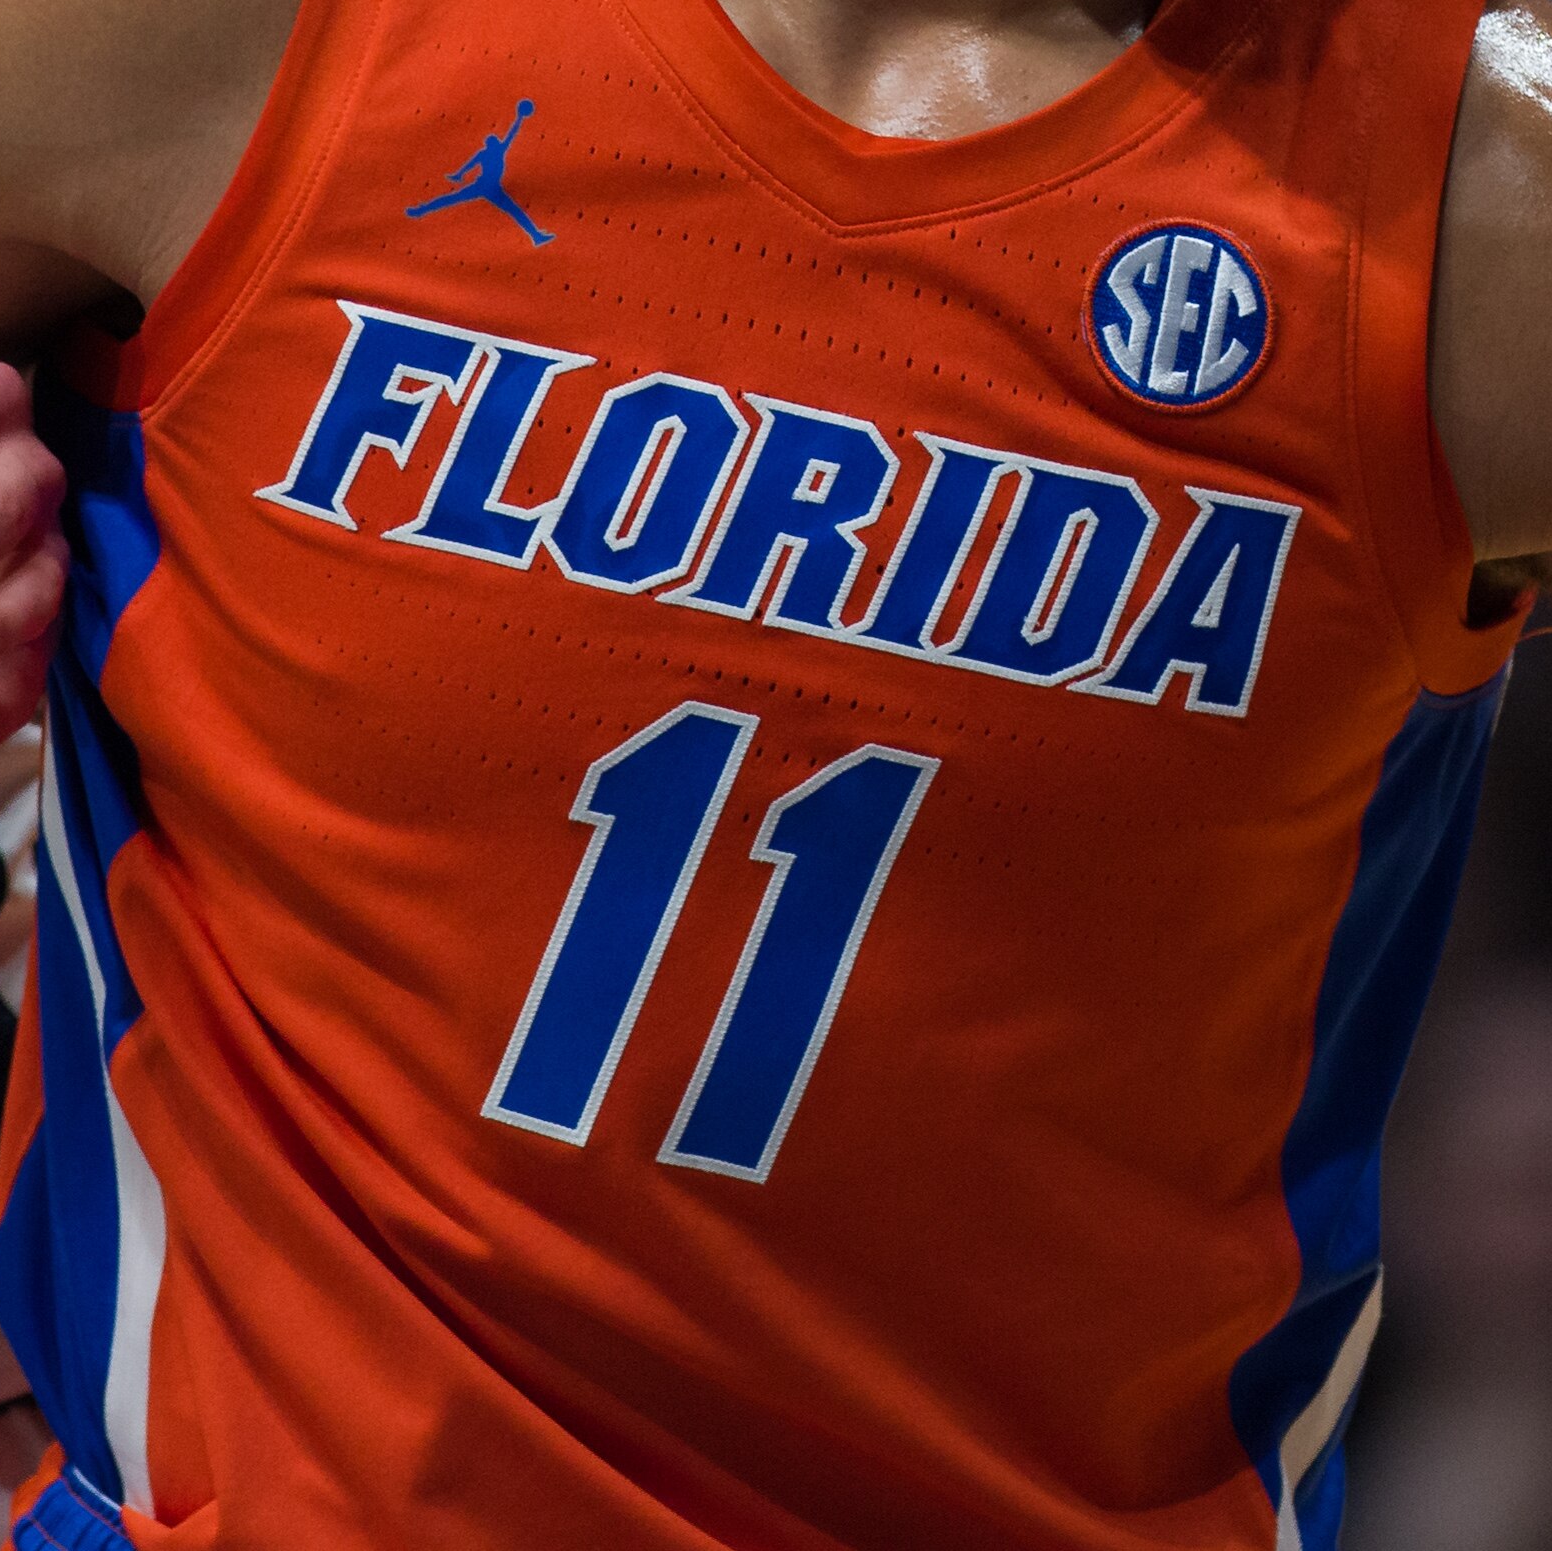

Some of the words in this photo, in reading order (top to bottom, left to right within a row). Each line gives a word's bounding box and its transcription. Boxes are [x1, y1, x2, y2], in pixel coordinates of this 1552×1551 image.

[252, 298, 1302, 717] FLORIDA
[1103, 235, 1257, 396] SEC
[480, 700, 941, 1184] 11
